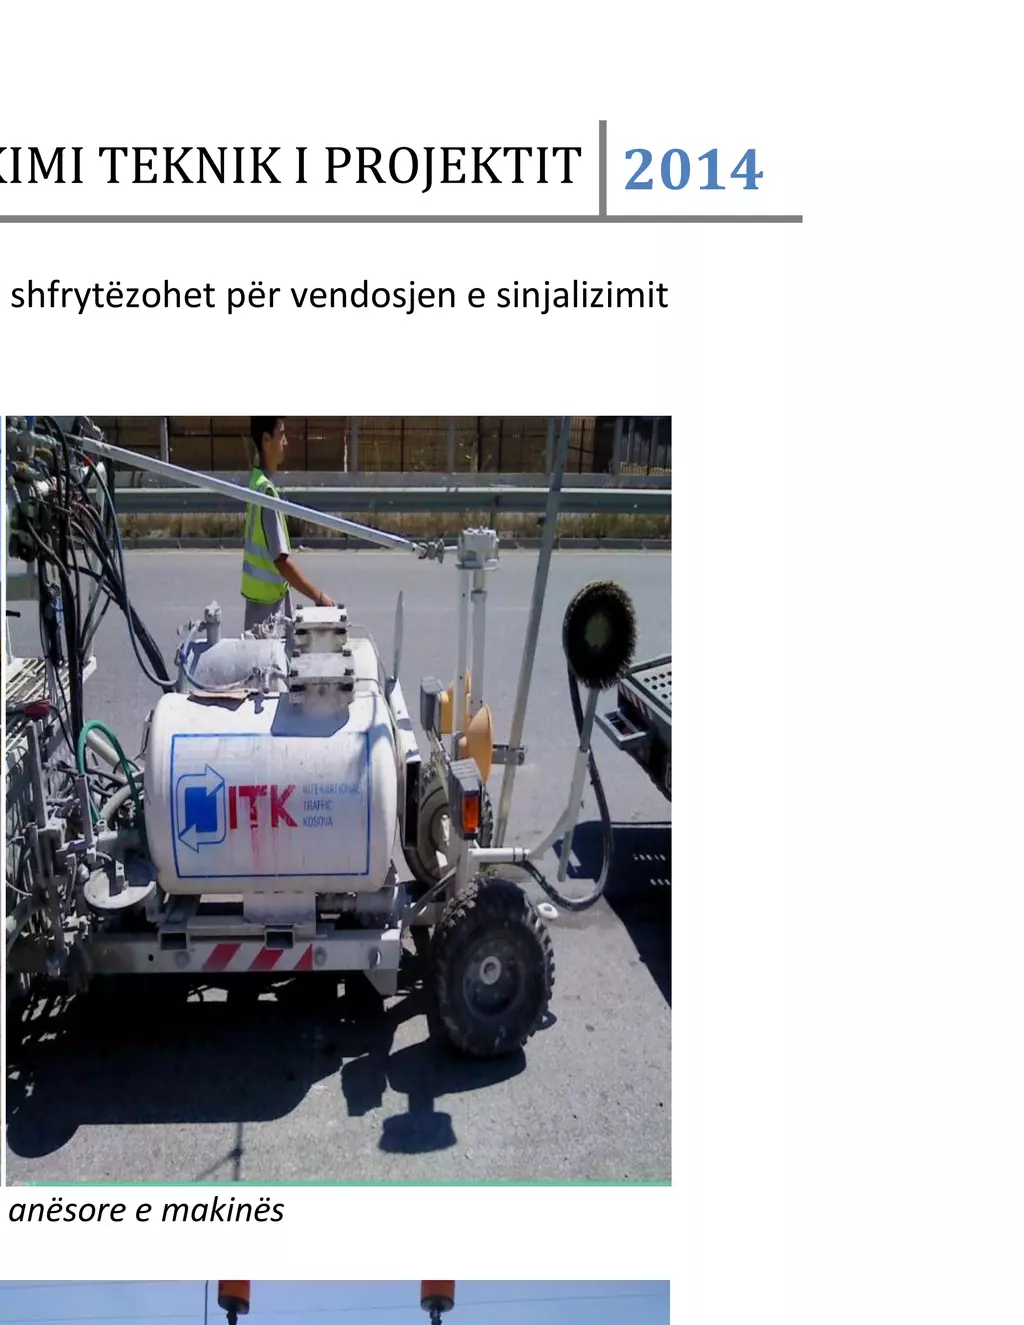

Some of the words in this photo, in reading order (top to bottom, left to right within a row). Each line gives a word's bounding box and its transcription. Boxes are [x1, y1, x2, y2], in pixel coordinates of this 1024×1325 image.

[99, 147, 281, 183] TEKNIK
[296, 147, 307, 183] I
[325, 147, 581, 193] PROJEKTIT
[625, 149, 763, 190] 2014
[11, 279, 215, 314] shfrytëzohet
[228, 281, 280, 314] për
[291, 280, 455, 314] vendosjen
[468, 288, 485, 308] e
[497, 280, 668, 314] sinjalizimit
[229, 784, 297, 829] ITK
[302, 816, 333, 827] KOSOVA
[303, 800, 332, 811] TRAFFIC
[9, 1197, 126, 1222] anësore
[136, 1204, 152, 1222] e
[162, 1196, 284, 1222] makinës
